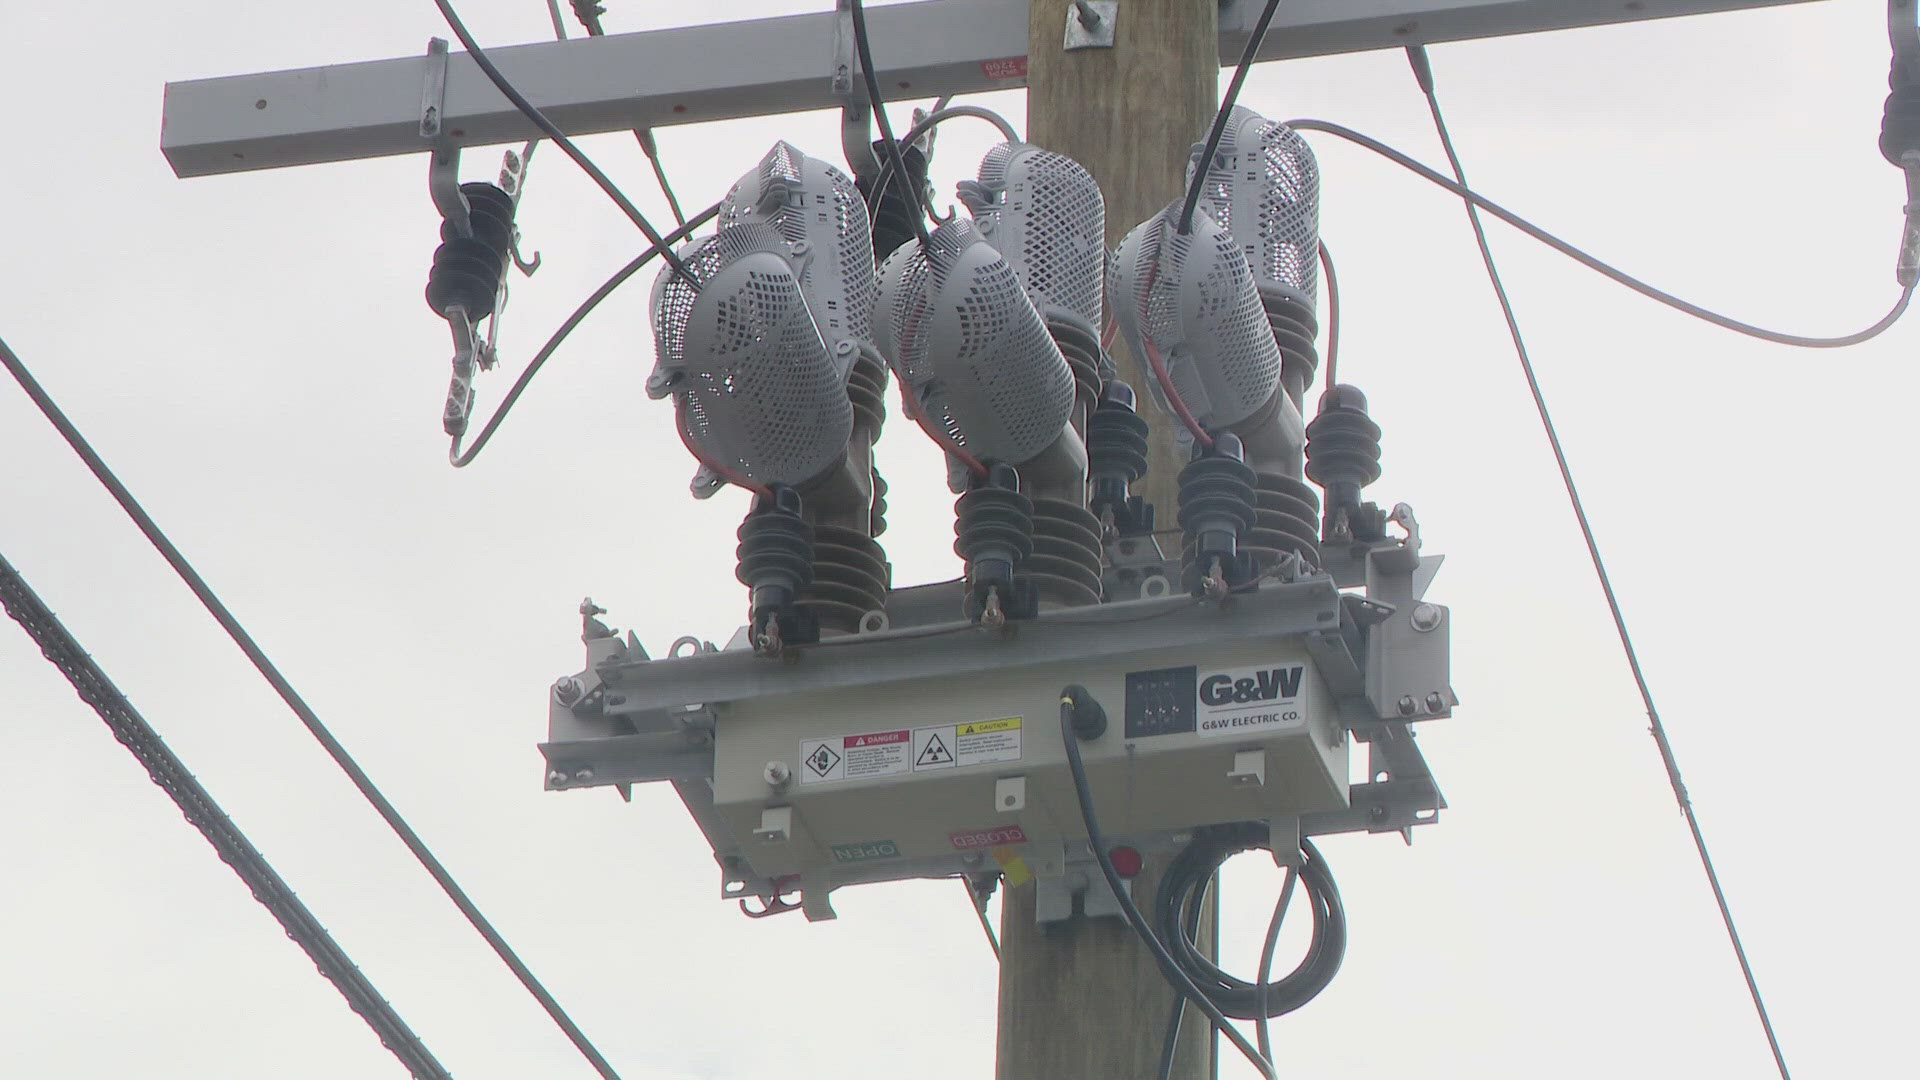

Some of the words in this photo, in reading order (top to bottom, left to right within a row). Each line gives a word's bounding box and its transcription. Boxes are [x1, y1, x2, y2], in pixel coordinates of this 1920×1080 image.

[1200, 667, 1303, 706] G&W
[979, 721, 1009, 731] CAUTION
[1202, 719, 1229, 731] G&W
[1232, 713, 1279, 727] ELECTRIC
[1282, 711, 1300, 721] CO.
[867, 733, 899, 743] DANGER
[954, 828, 1022, 847] CLOSED
[835, 843, 895, 859] OPEN
